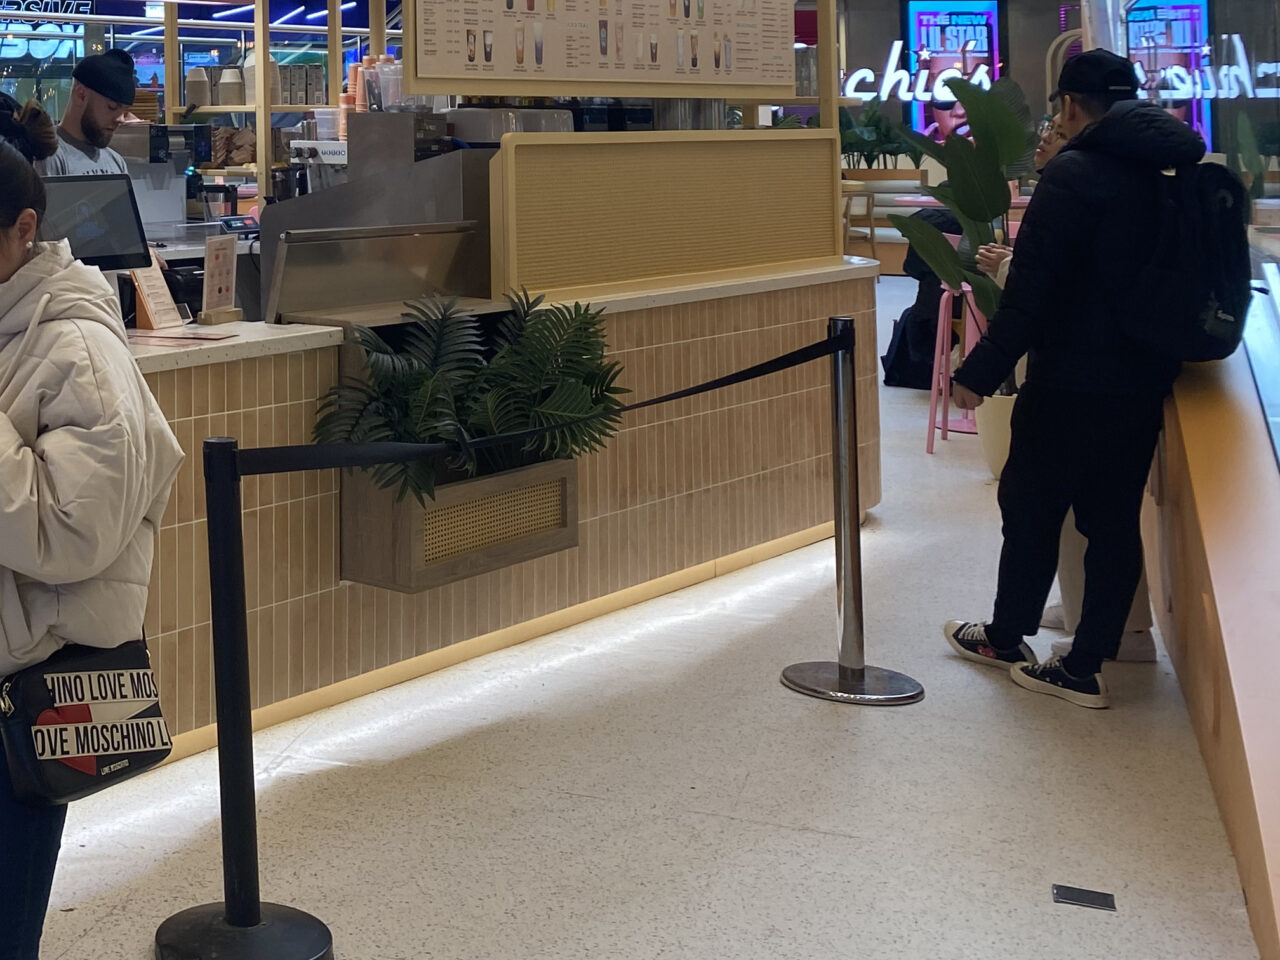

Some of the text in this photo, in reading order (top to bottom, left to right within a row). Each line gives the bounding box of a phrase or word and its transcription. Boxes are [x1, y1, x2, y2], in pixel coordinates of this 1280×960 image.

[919, 14, 988, 25] THE NEW
[944, 25, 989, 52] STAR
[87, 671, 129, 702] LOVE
[74, 720, 157, 756] MOSCHINO
